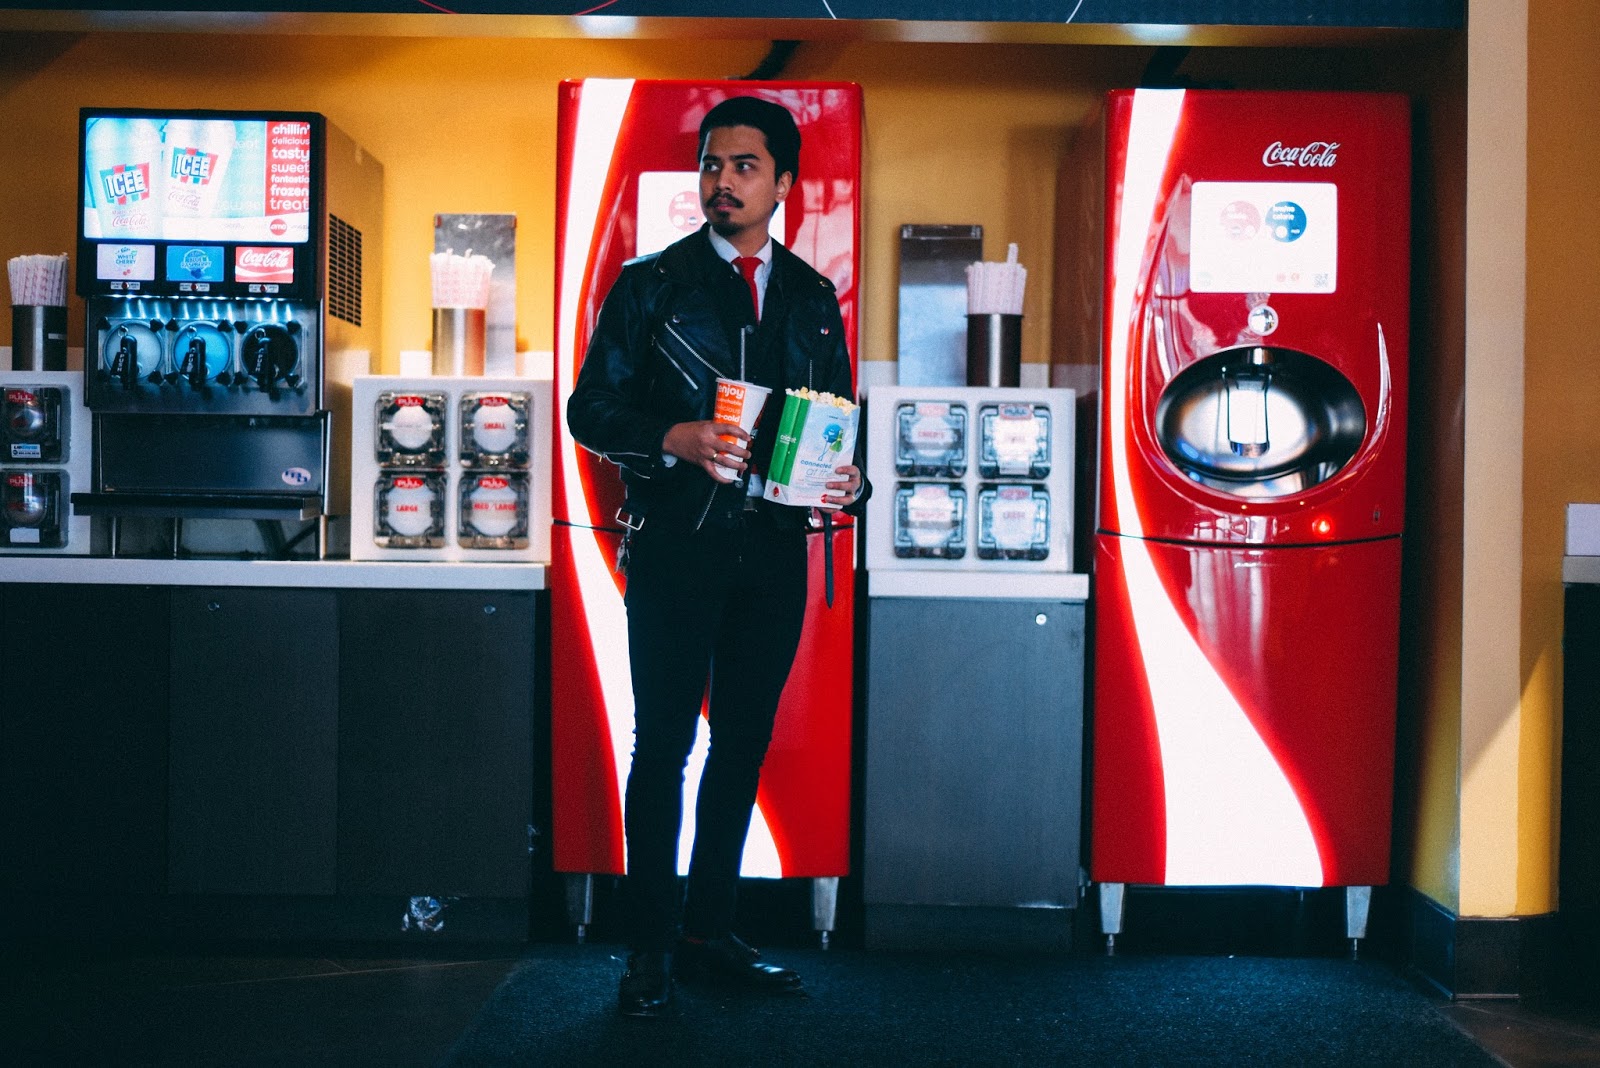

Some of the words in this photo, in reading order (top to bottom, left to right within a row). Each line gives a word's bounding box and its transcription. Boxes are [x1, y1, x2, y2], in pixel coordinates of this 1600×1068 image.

[272, 124, 310, 135] chillin'
[272, 137, 310, 145] delicious
[272, 147, 310, 162] tasty
[1262, 141, 1340, 167] Coca-Cola
[175, 154, 210, 178] ICEE
[271, 163, 310, 173] sweet
[106, 170, 145, 198] ICEE
[271, 174, 310, 183] fantastic
[270, 184, 309, 197] frozen
[270, 198, 309, 210] treat
[239, 250, 291, 267] Coca-Cola
[117, 353, 125, 372] PUSH
[255, 354, 263, 372] PUSH
[9, 393, 32, 401] PULL
[718, 384, 744, 399] enjoy
[483, 397, 506, 405] PULL
[484, 422, 506, 430] SMALL
[800, 459, 832, 469] connected
[396, 504, 418, 512] LARGE
